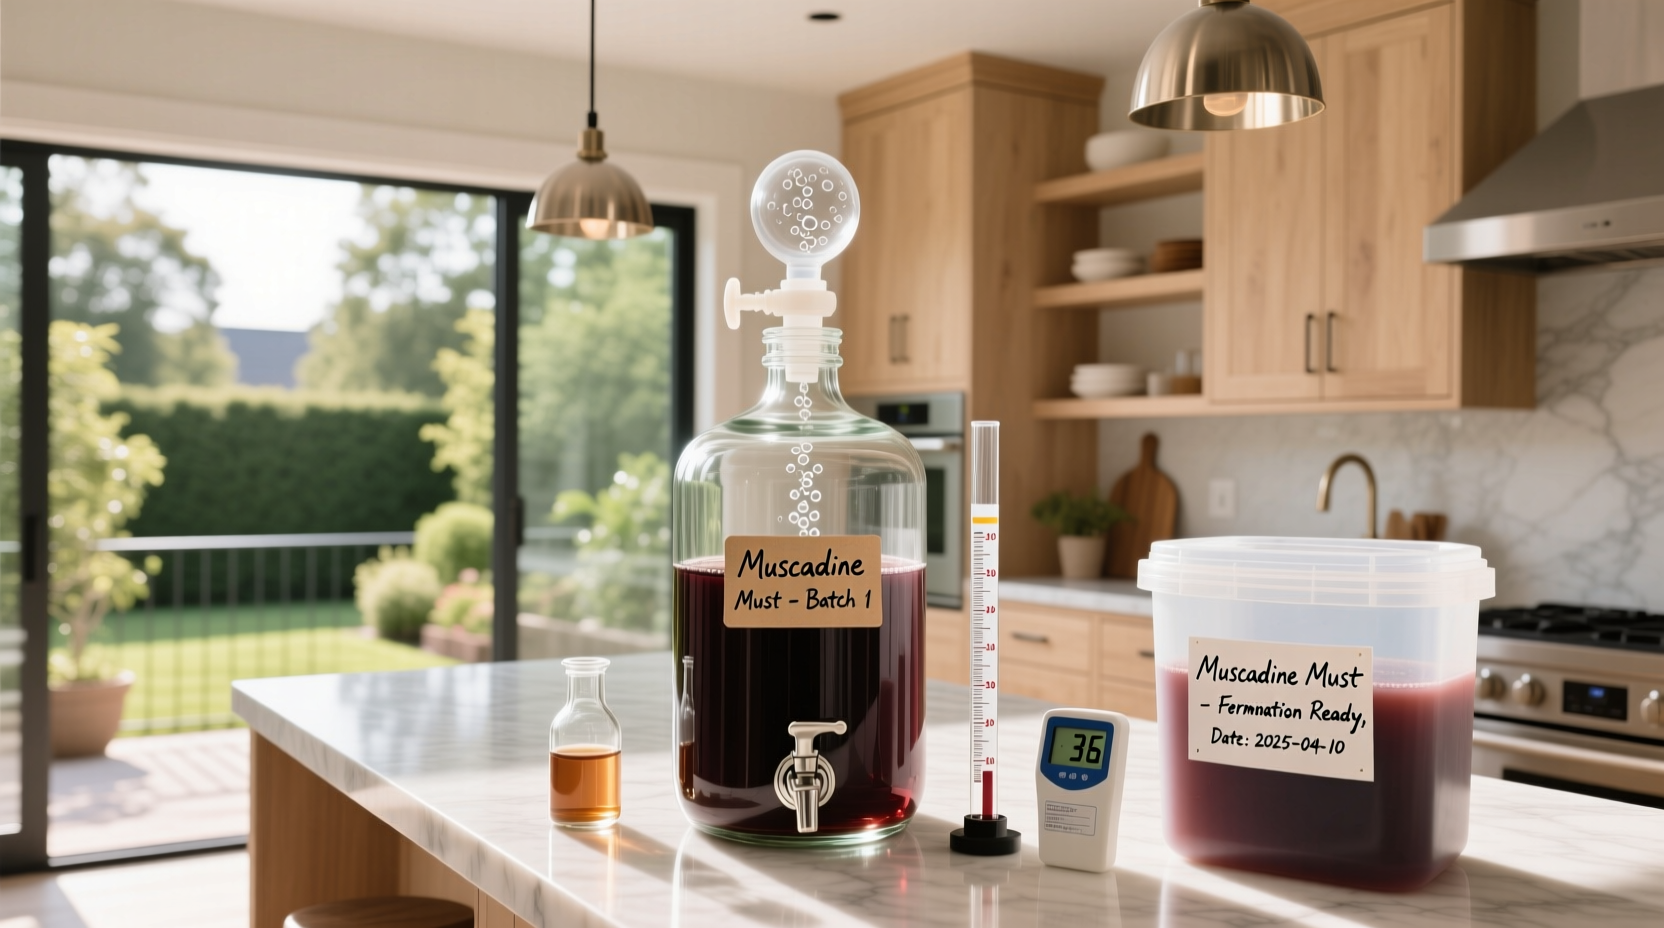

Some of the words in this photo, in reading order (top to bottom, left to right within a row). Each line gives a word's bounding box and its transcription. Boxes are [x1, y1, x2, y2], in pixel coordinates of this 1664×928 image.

[737, 548, 865, 579] Muscadine
[734, 589, 782, 611] Must
[806, 587, 856, 610] Batch
[865, 589, 871, 609] 1
[1196, 654, 1299, 686] Muscadine
[1305, 661, 1364, 688] Must
[1309, 699, 1366, 735] Ready,
[1069, 733, 1104, 764] 36
[1211, 726, 1249, 747] Date:
[1254, 733, 1345, 755] 2025-04-10
